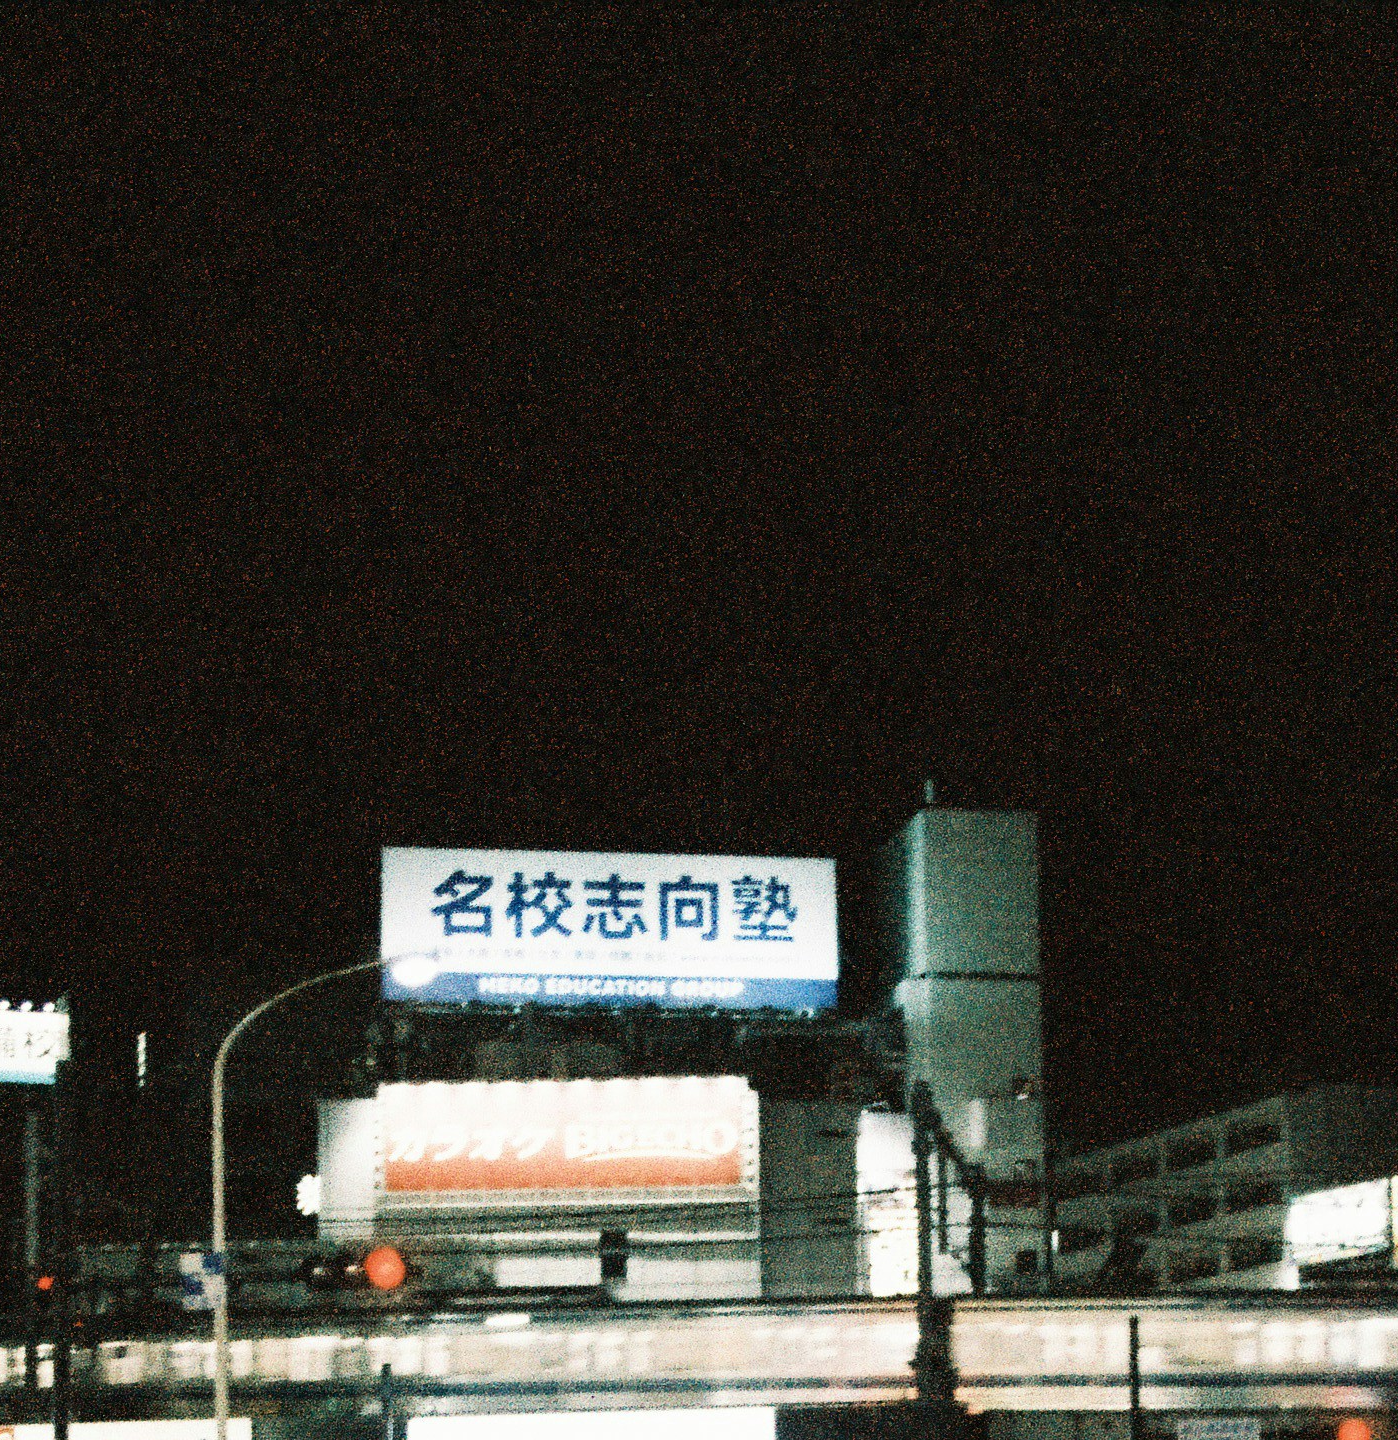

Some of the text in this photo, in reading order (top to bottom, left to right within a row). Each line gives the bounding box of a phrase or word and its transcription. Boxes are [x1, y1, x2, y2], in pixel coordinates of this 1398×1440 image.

[431, 869, 798, 943] 名校志向塾
[545, 977, 666, 998] EDUCATION
[670, 980, 745, 999] GROUP
[387, 1121, 558, 1163] カラオケ
